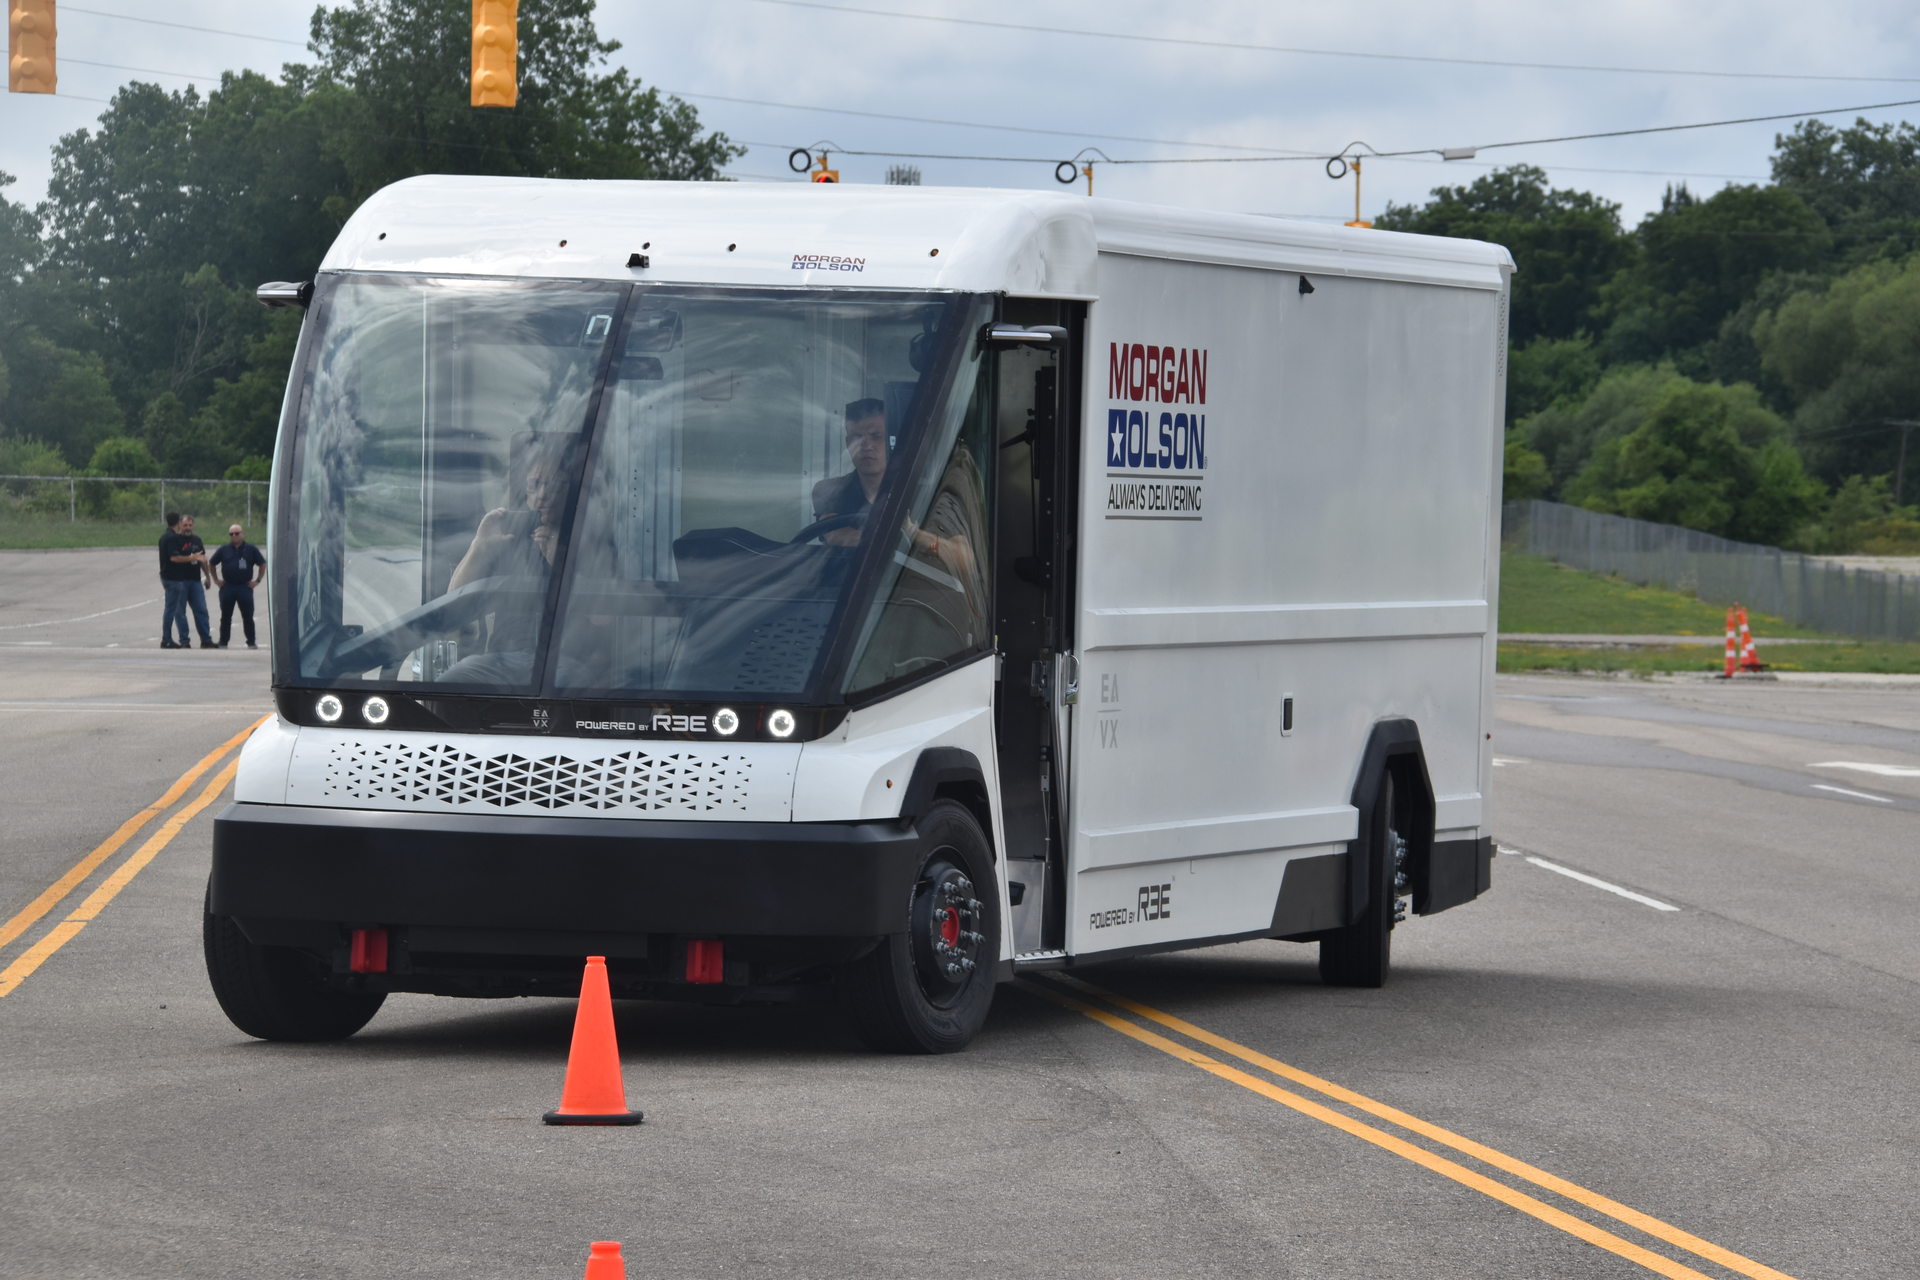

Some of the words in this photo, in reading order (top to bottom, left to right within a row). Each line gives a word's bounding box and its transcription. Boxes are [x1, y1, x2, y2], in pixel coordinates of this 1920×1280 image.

[793, 254, 866, 265] MORGAN
[805, 262, 864, 273] OLSON
[1109, 342, 1207, 404] MORGAN
[1127, 410, 1205, 469] OLSON
[1107, 483, 1146, 510] ALWAYS
[1148, 484, 1202, 511] DELIVERING
[1101, 673, 1119, 703] EA
[532, 719, 549, 728] VX
[533, 709, 549, 717] EA
[575, 720, 636, 731] POWERED
[1100, 719, 1118, 749] VX
[1089, 908, 1127, 930] POWERED
[1129, 911, 1136, 923] BY
